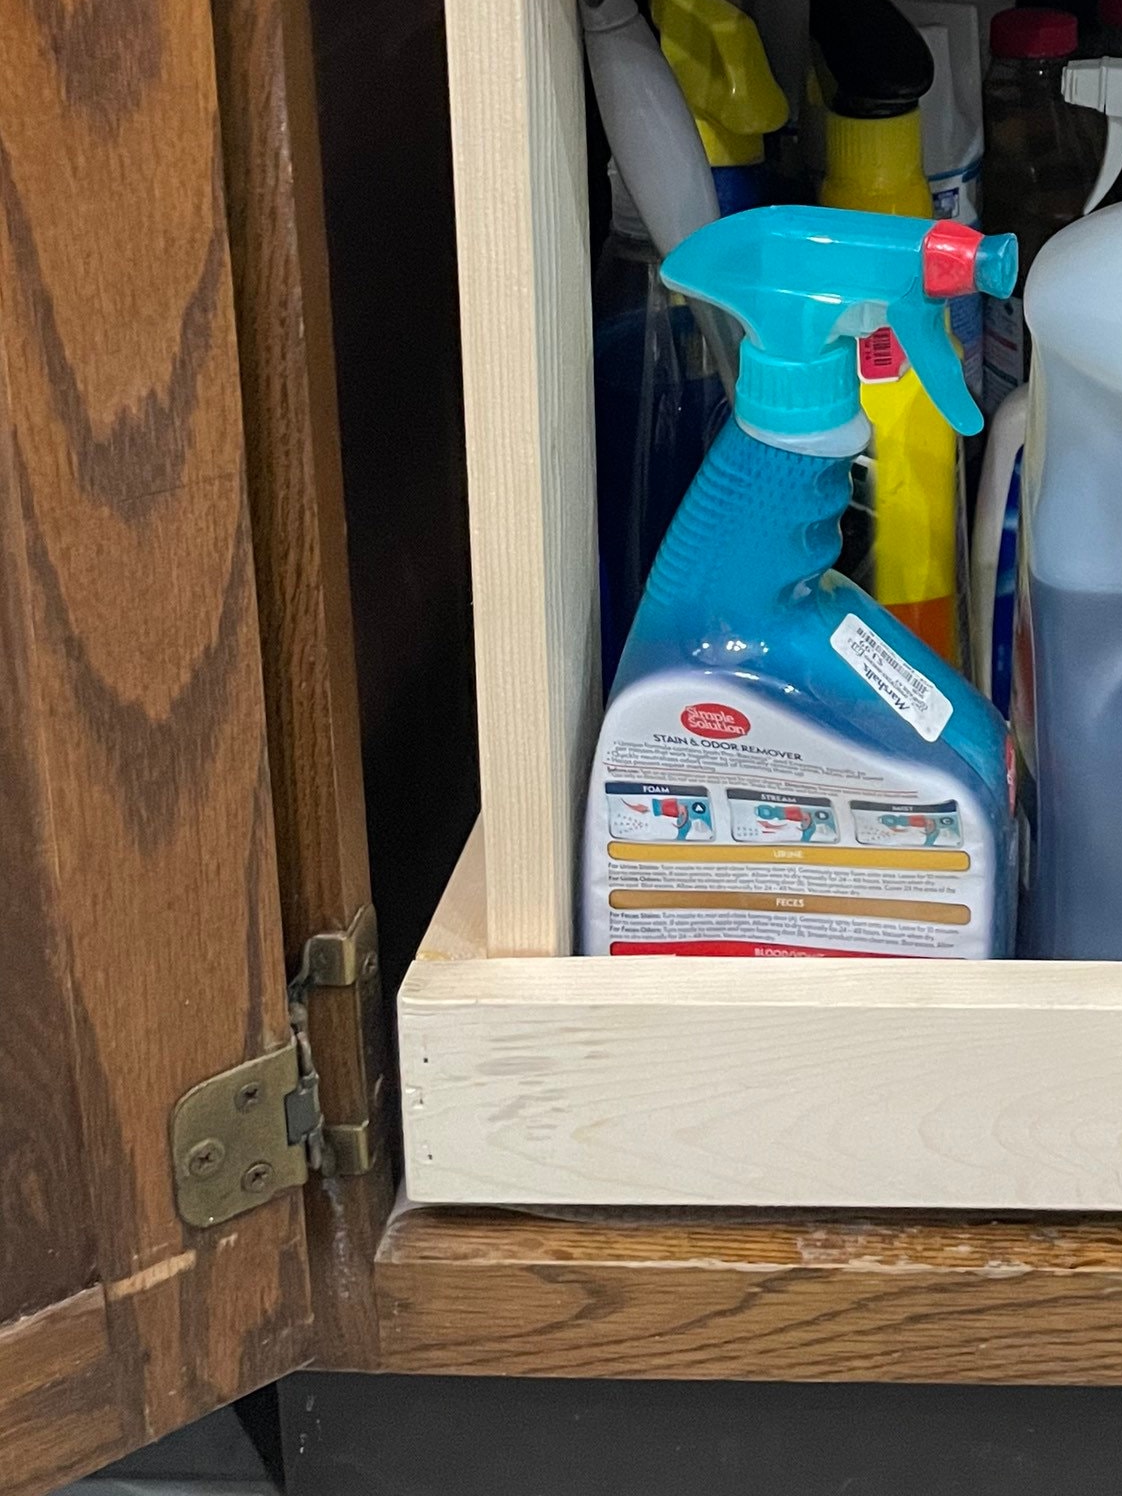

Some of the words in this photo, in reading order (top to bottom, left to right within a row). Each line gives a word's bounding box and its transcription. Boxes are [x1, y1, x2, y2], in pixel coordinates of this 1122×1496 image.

[863, 662, 911, 711] Marshalls
[686, 706, 735, 724] Simple
[687, 716, 746, 736] Solution
[653, 733, 689, 746] STAIN
[690, 737, 699, 746] &
[701, 739, 739, 751] ODOR
[741, 745, 804, 762] REMOVER
[642, 785, 670, 794] FOAM
[760, 793, 797, 803] STREAM
[776, 898, 804, 908] FECES
